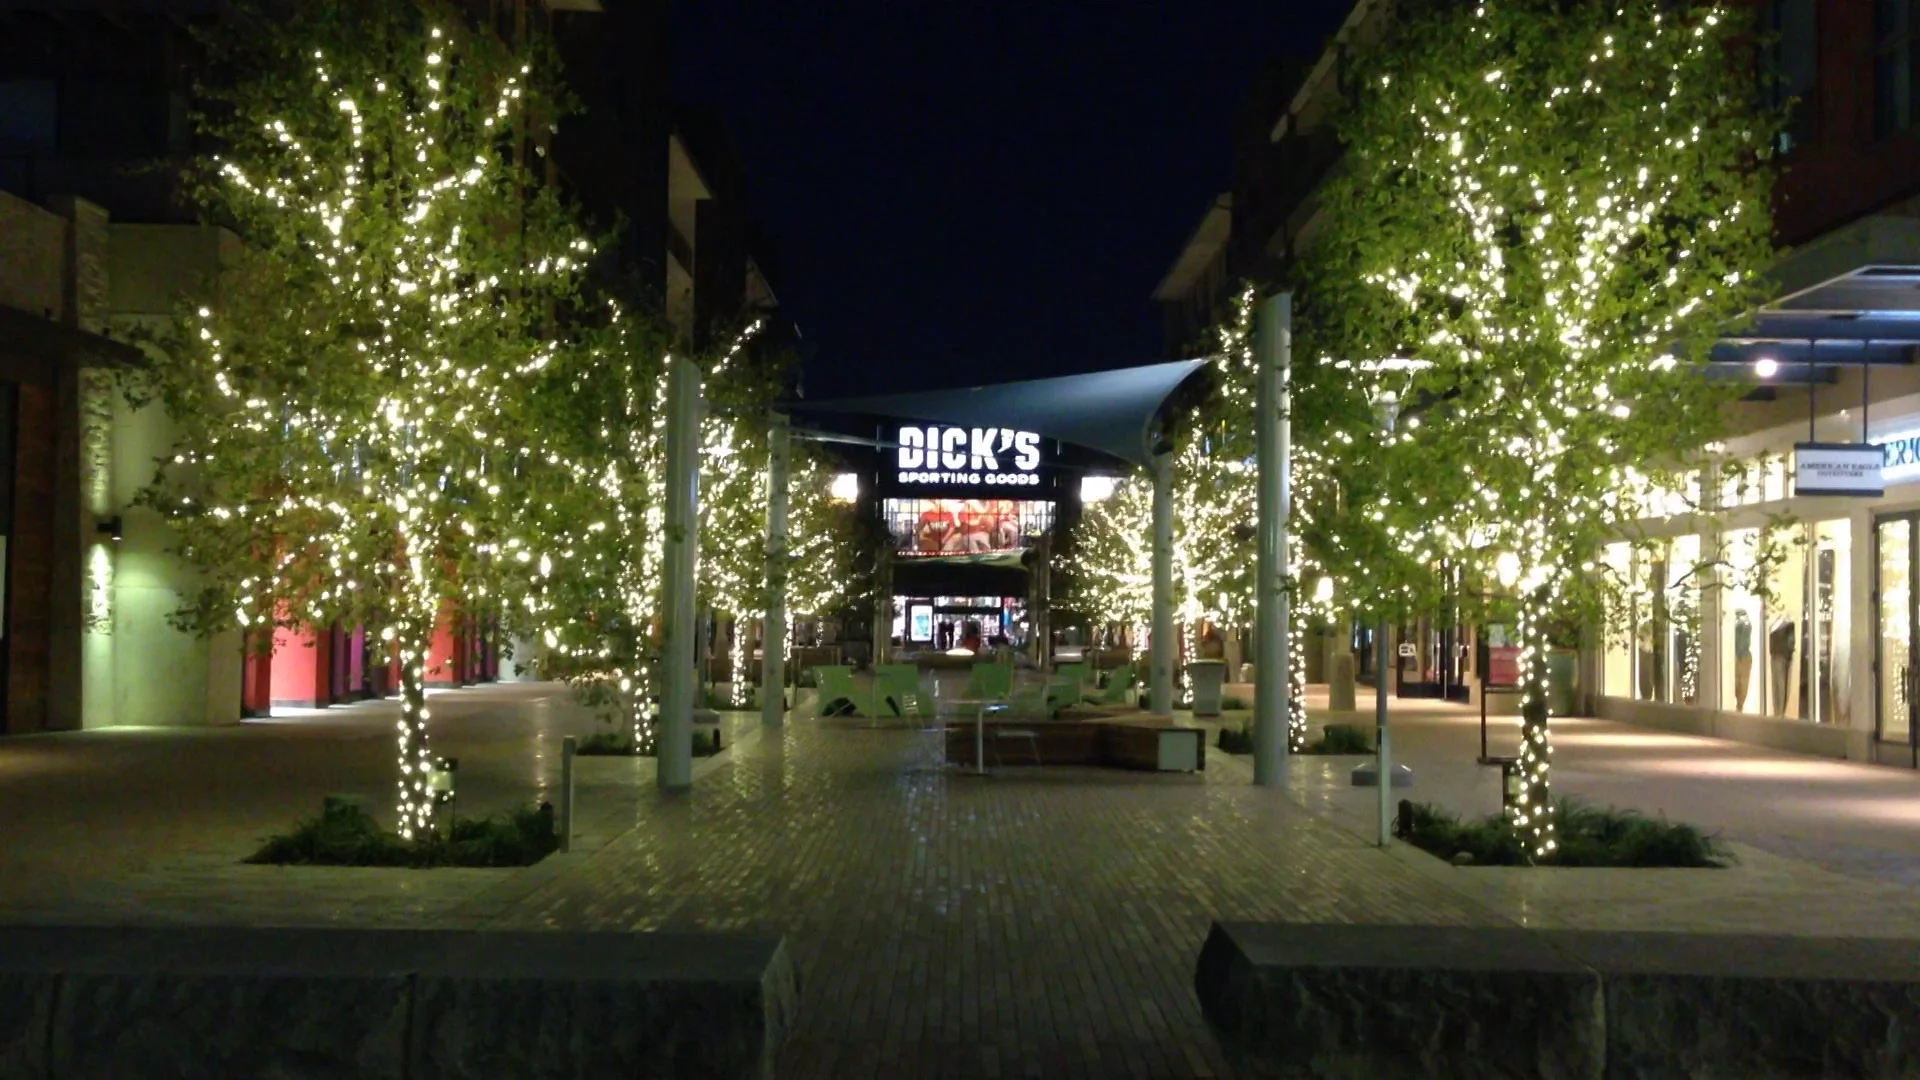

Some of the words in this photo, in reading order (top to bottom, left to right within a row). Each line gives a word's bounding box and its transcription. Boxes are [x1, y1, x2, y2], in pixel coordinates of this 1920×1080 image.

[898, 426, 1040, 470] DICK'S
[898, 471, 981, 484] SPORTING
[984, 473, 1040, 485] GOODS
